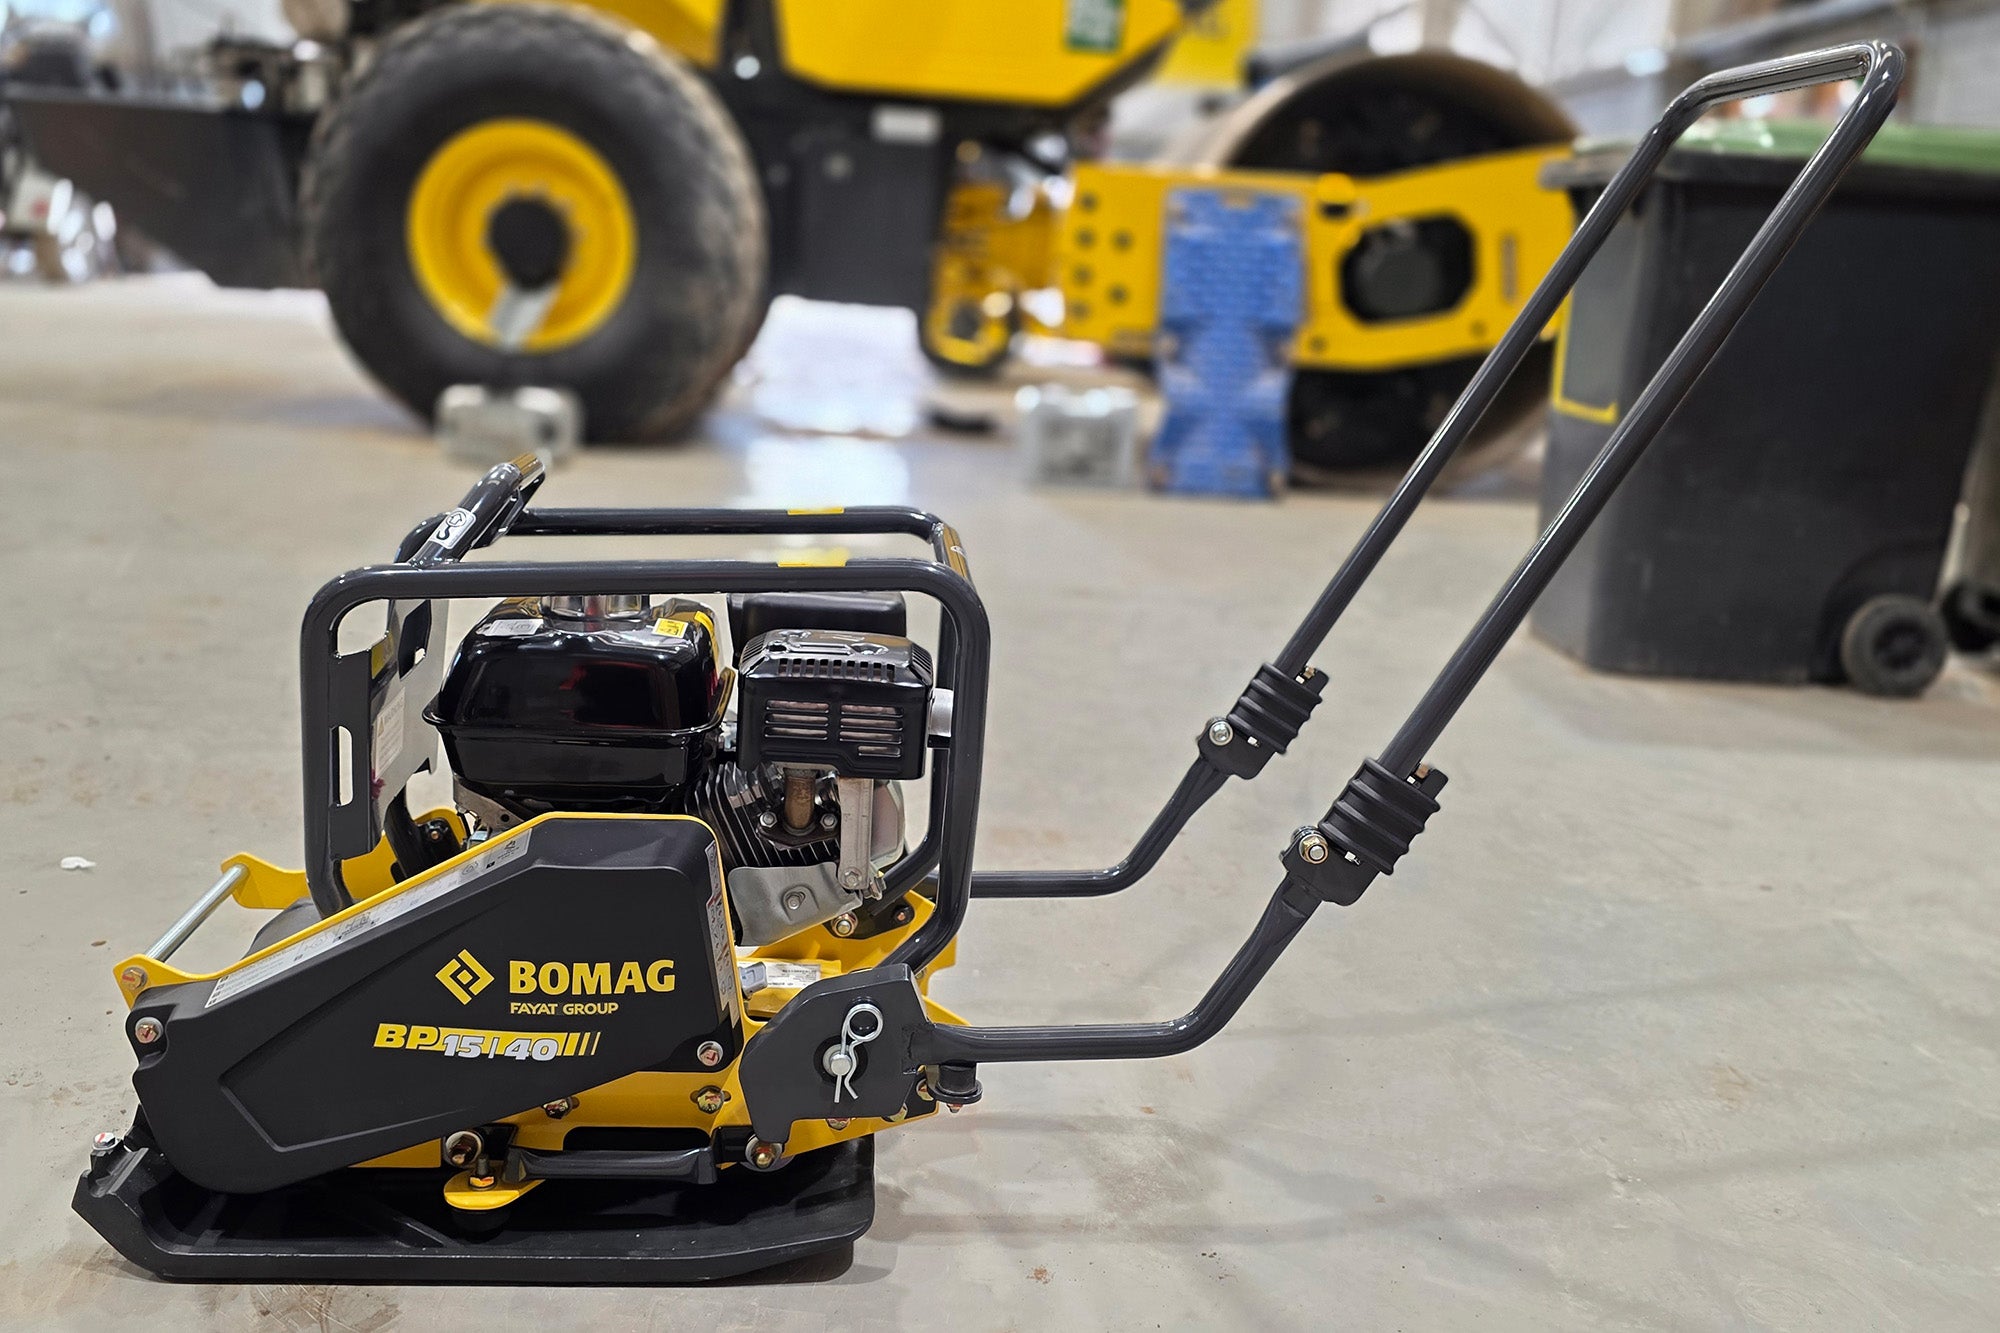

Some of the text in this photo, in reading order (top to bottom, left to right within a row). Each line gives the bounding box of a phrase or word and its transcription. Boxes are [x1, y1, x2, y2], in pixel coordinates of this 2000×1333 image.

[509, 959, 676, 995] BOMAG
[510, 1002, 618, 1015] FAYAT GROUP
